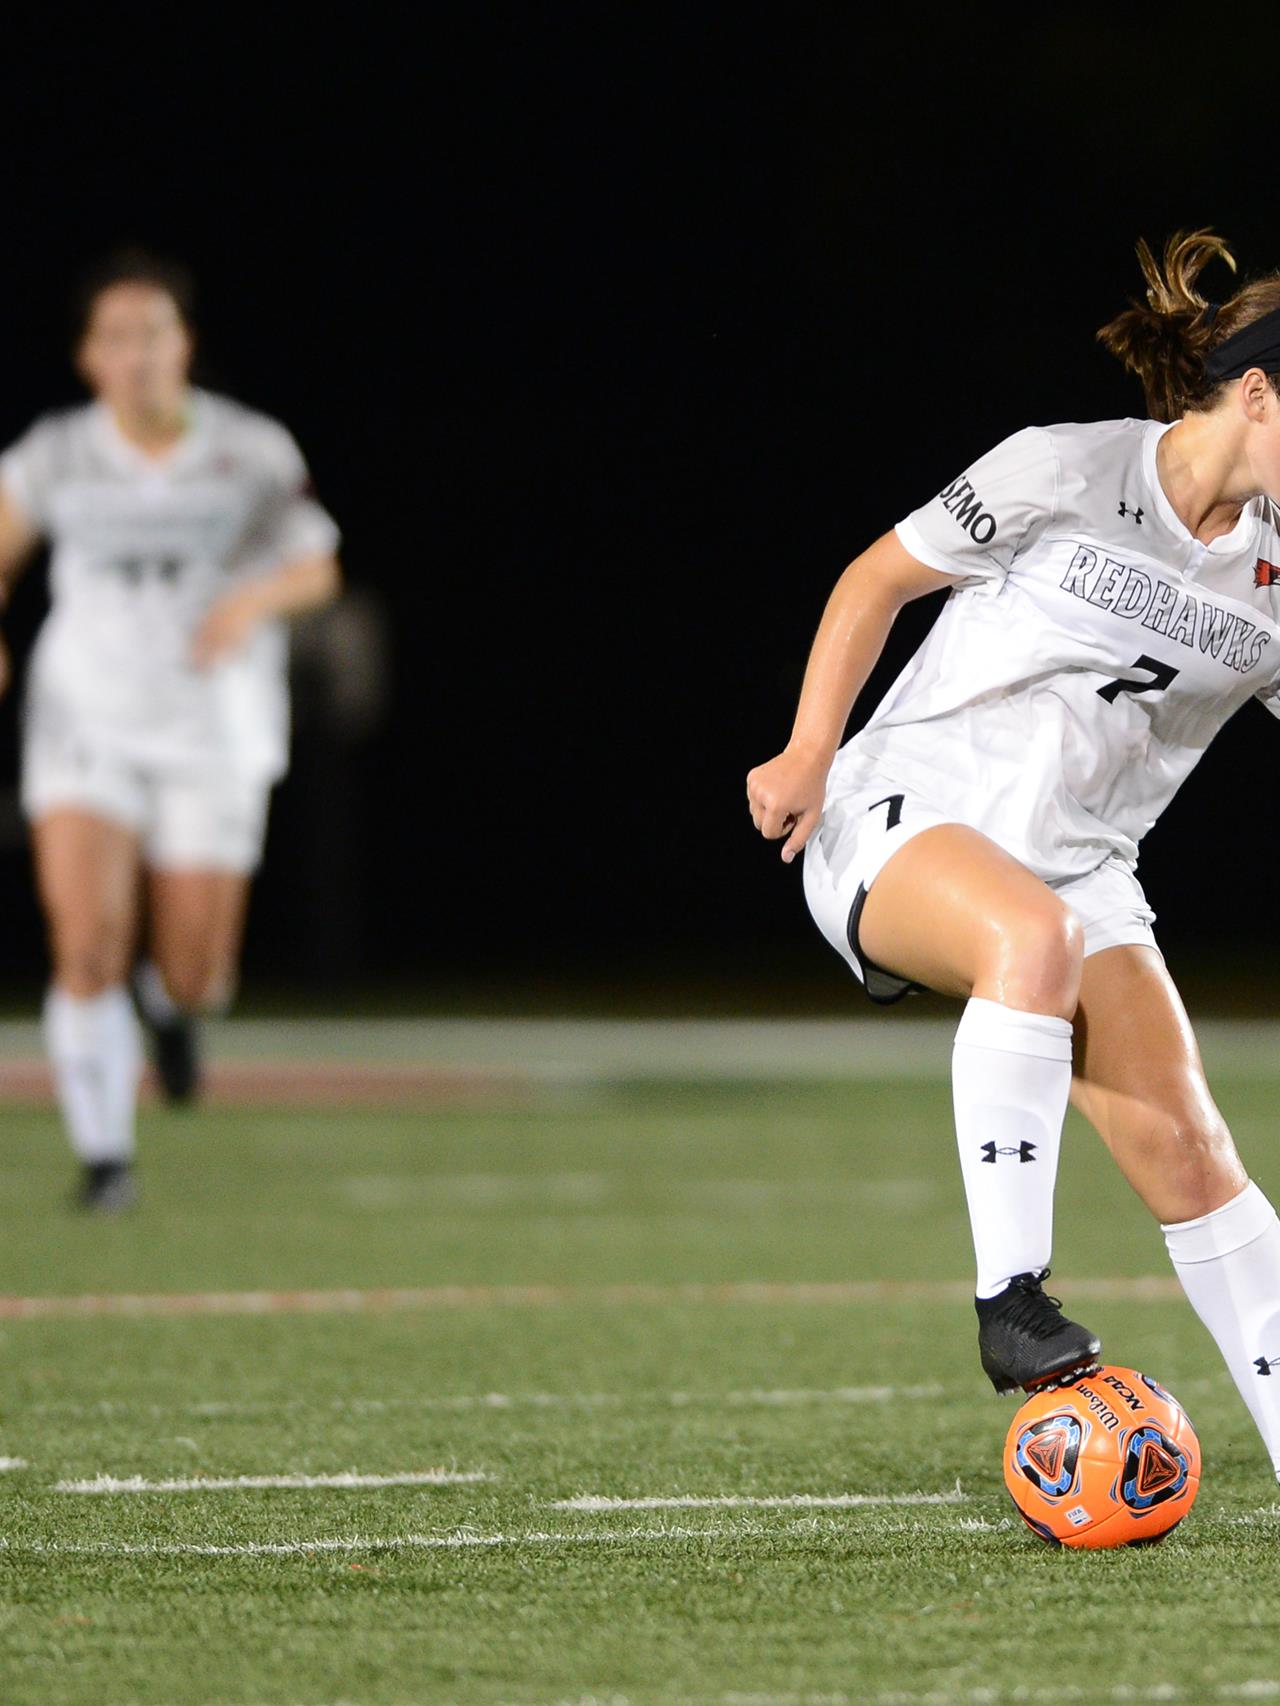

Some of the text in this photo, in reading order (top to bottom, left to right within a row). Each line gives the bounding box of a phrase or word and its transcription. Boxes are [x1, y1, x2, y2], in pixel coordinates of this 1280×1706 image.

[940, 475, 997, 544] SEMO
[1059, 545, 1271, 674] REDHAWKS
[868, 793, 906, 832] 7
[1075, 1383, 1119, 1431] Wilson
[1102, 1375, 1144, 1411] NCAA
